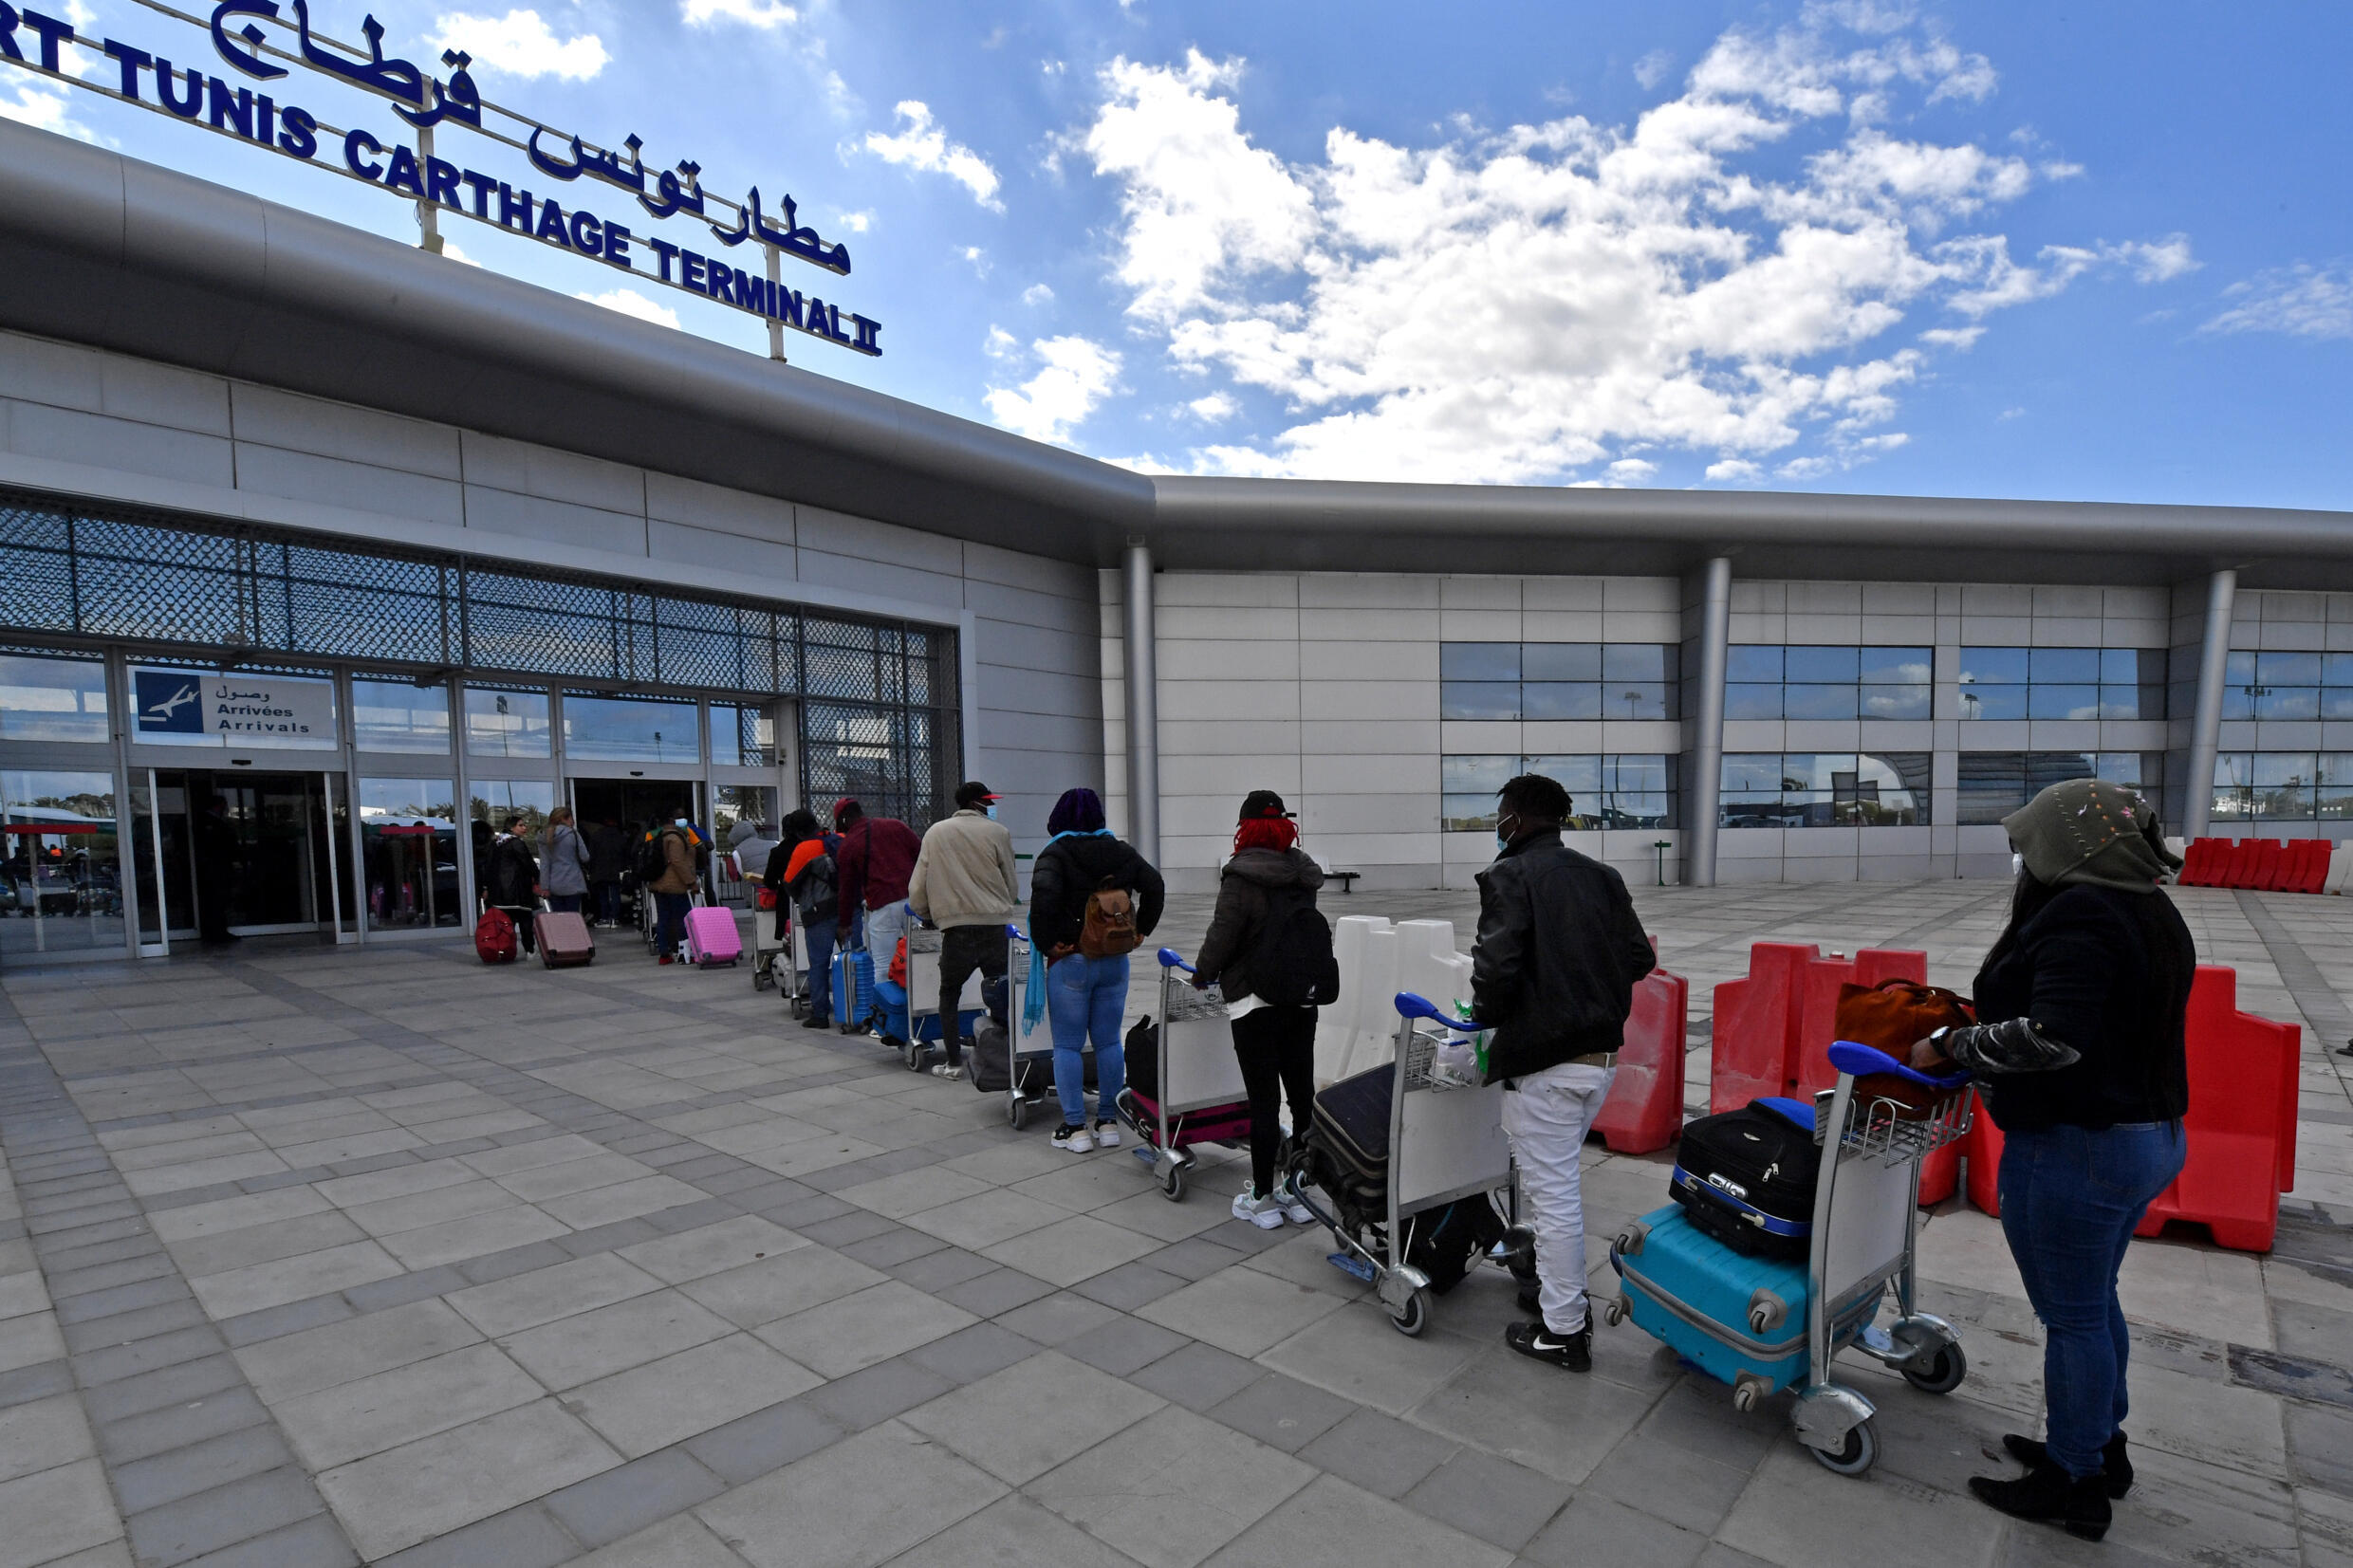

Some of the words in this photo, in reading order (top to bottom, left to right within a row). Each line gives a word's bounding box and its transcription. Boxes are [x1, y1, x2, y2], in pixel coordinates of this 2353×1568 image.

[211, 0, 482, 129] قرطاج
[103, 38, 318, 159] TUNIS
[343, 129, 631, 268] CARTHAGE
[650, 236, 851, 344] TERMINAL
[852, 313, 882, 358] II
[528, 124, 704, 219] تونس
[711, 185, 851, 275] مطار
[215, 685, 270, 703] وصول
[217, 704, 294, 717] Arrivées
[218, 719, 310, 733] Arrivals
